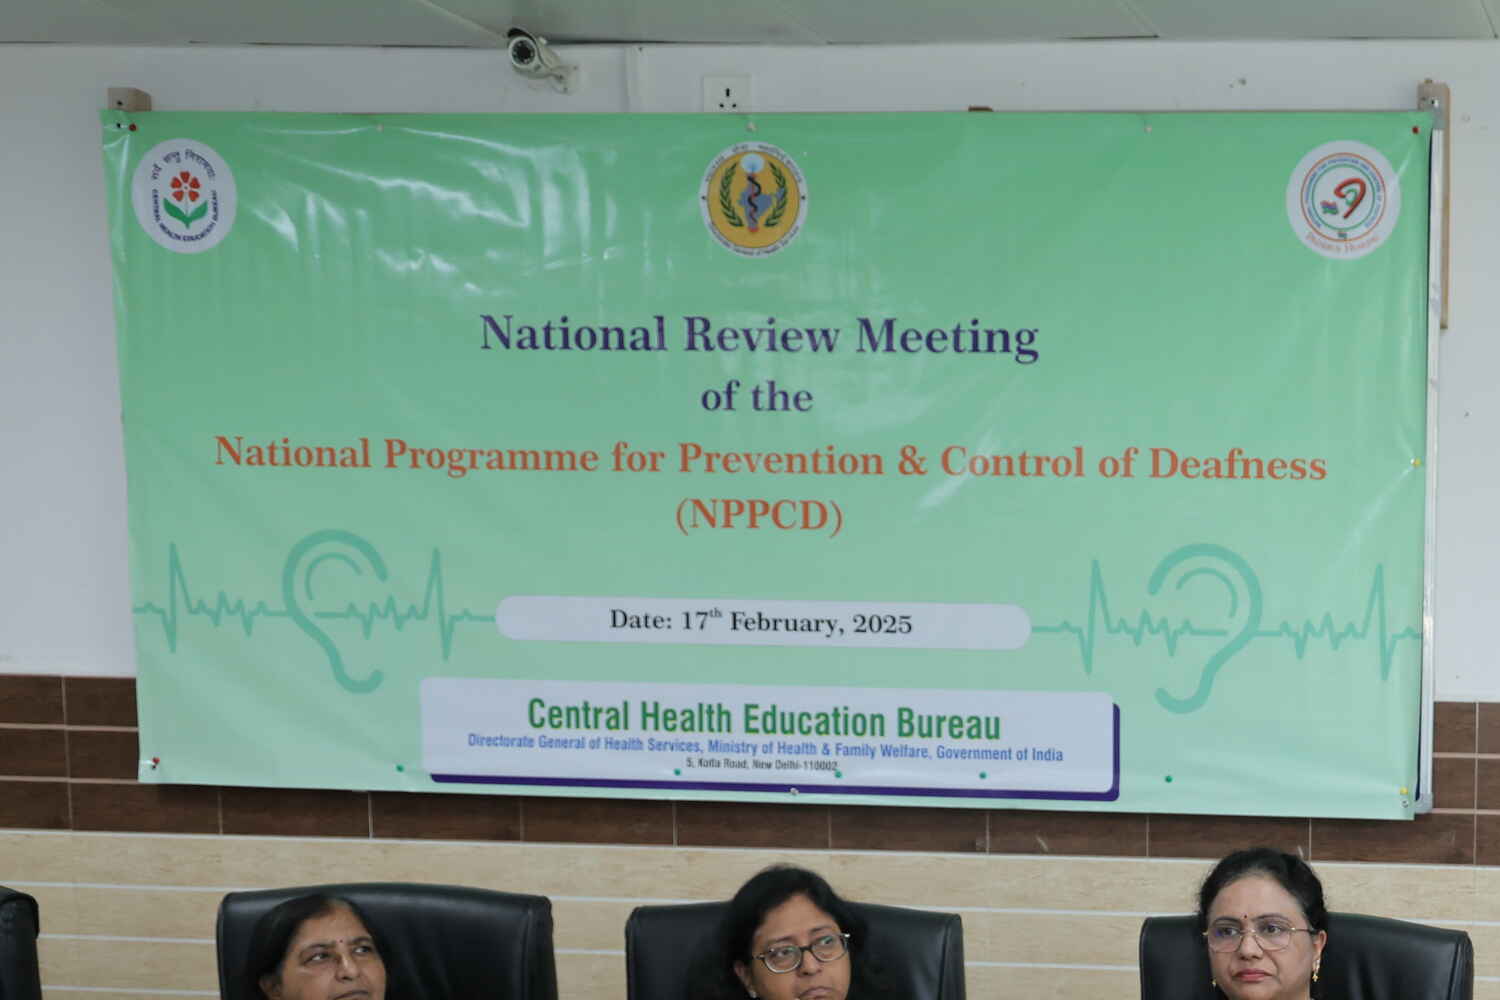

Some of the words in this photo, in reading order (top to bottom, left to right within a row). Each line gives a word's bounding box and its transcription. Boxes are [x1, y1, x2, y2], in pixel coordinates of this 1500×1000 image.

[480, 314, 669, 352] National
[682, 316, 841, 353] Review
[856, 317, 1040, 365] Meeting
[701, 379, 741, 412] of
[751, 380, 814, 412] the
[214, 435, 372, 469] National
[383, 437, 599, 479] Programme
[611, 441, 667, 473] for
[678, 442, 885, 475] Prevention
[898, 445, 928, 476] &
[940, 444, 1086, 478] Control
[1099, 446, 1139, 478] of
[1148, 447, 1328, 481] Deafness
[676, 497, 843, 539] (NPPCD)
[610, 608, 672, 630] Date:
[681, 607, 723, 631] 17th
[730, 611, 845, 639] February,
[853, 613, 913, 635] 2025
[528, 697, 629, 731] Central
[641, 700, 732, 734] Health
[744, 703, 885, 737] Education
[897, 706, 1001, 740] Bureau
[468, 733, 535, 749] Directorate
[538, 734, 585, 750] General
[589, 735, 603, 750] of
[604, 736, 643, 751] Health
[648, 738, 703, 754] Services,
[708, 739, 758, 756] Ministry
[761, 741, 774, 755] of
[777, 741, 817, 755] Health
[821, 743, 831, 756] &
[835, 742, 876, 760] Family
[880, 744, 933, 760] Welfare,
[936, 745, 1012, 761] Government
[1016, 746, 1028, 761] of
[1032, 747, 1064, 762] India
